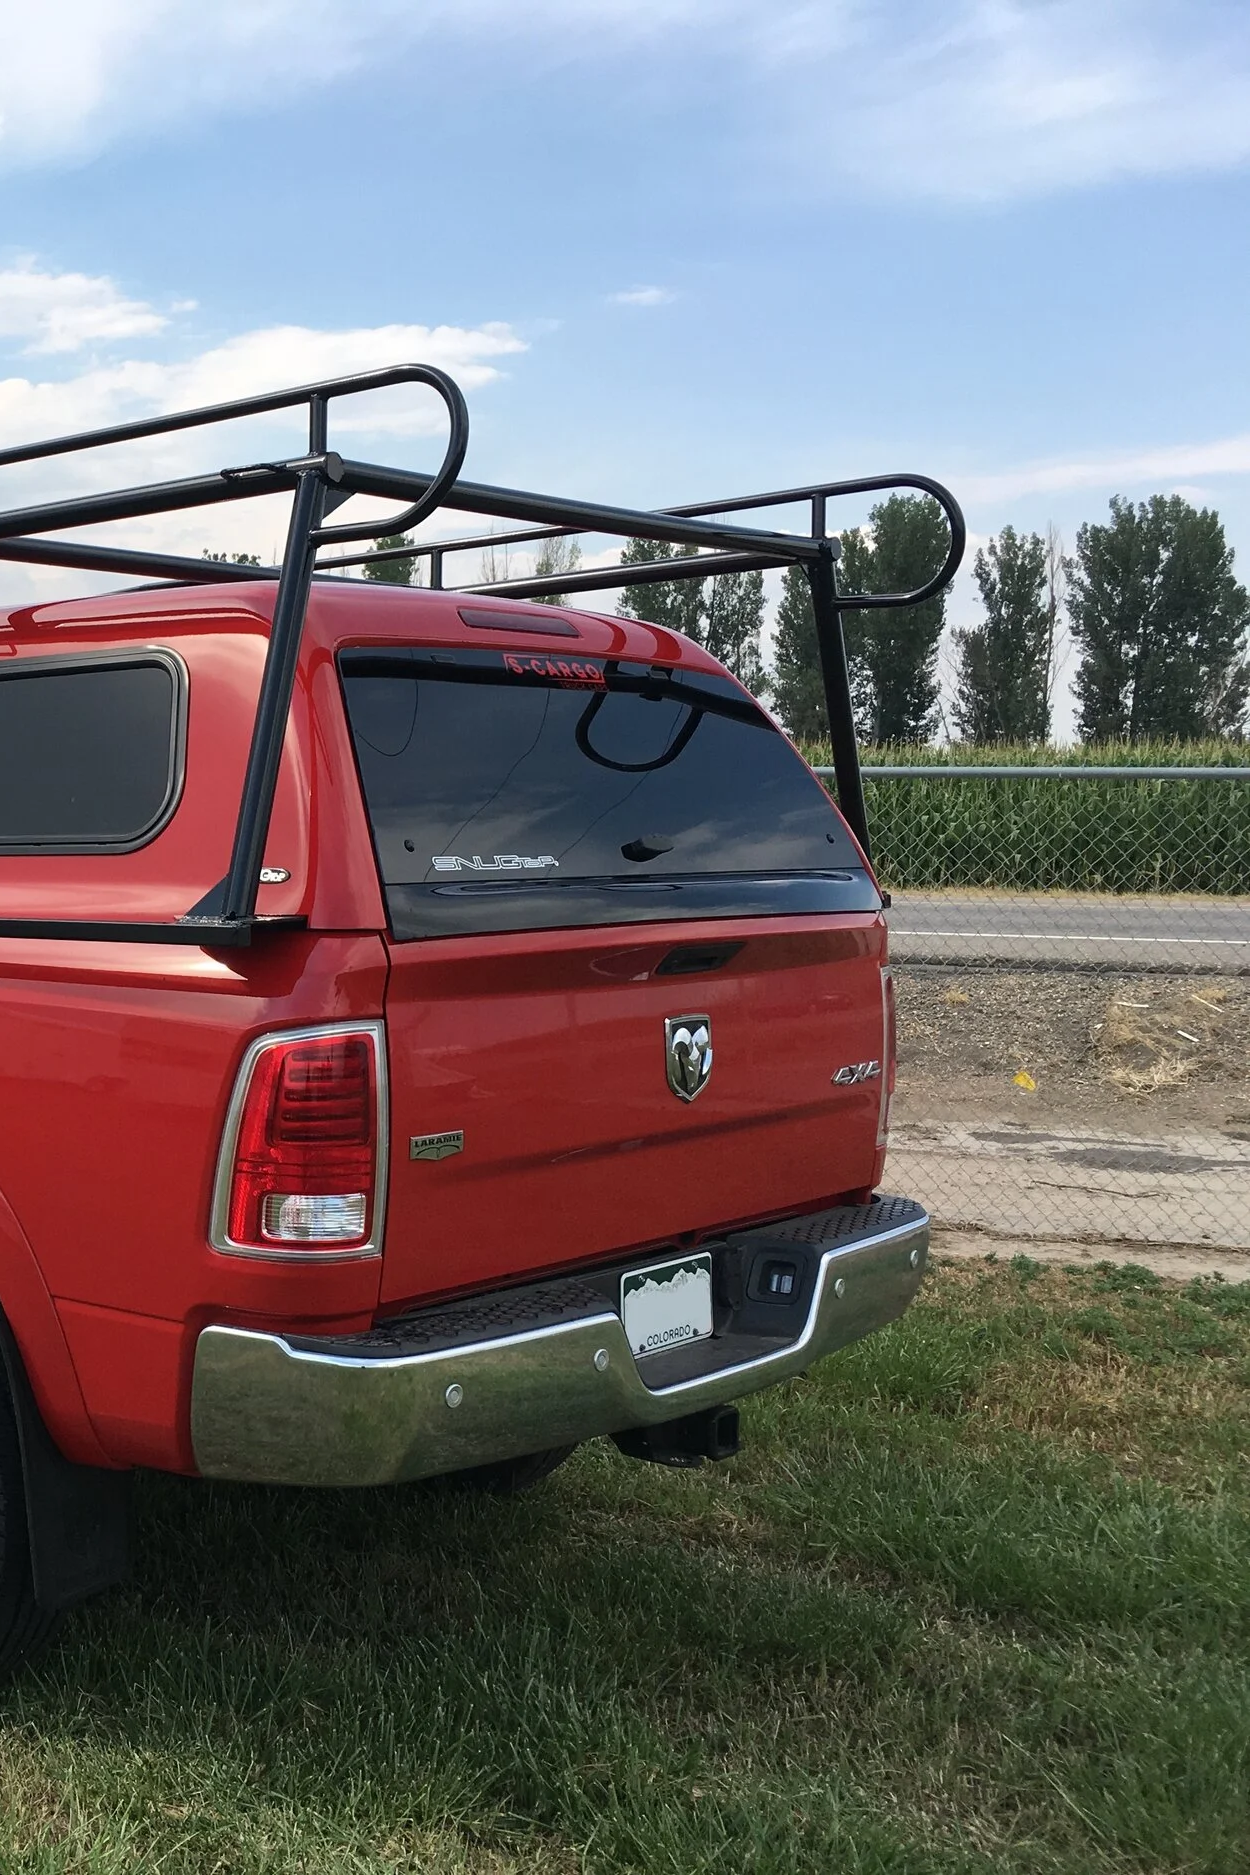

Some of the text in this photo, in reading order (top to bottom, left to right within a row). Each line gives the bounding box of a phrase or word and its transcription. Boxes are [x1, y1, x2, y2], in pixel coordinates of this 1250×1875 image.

[507, 657, 600, 679] S-CARGO
[414, 1134, 462, 1148] LARAMIE
[646, 1324, 691, 1347] COLORADO
